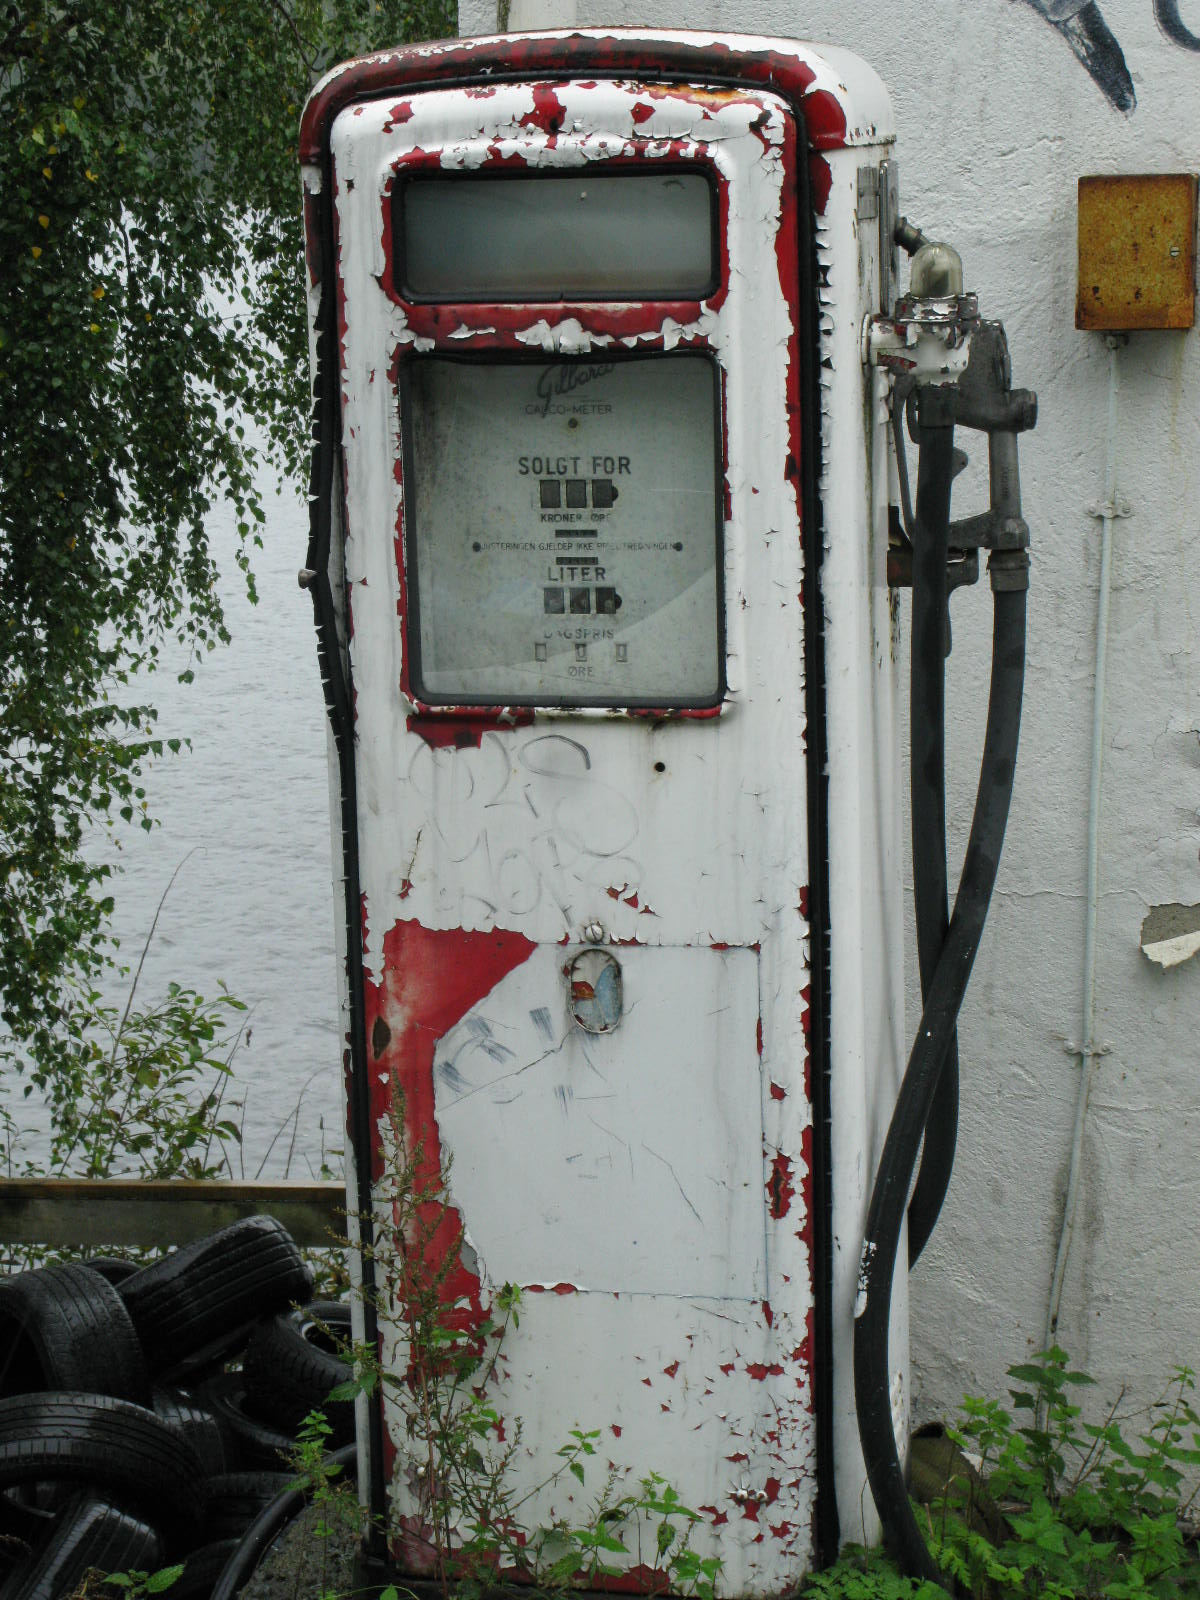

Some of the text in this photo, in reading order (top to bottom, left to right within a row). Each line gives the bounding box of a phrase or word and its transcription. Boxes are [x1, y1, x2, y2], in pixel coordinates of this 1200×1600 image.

[518, 456, 632, 476] SOLGT FOR
[547, 566, 607, 582] LITER
[567, 665, 594, 677] ØRE
